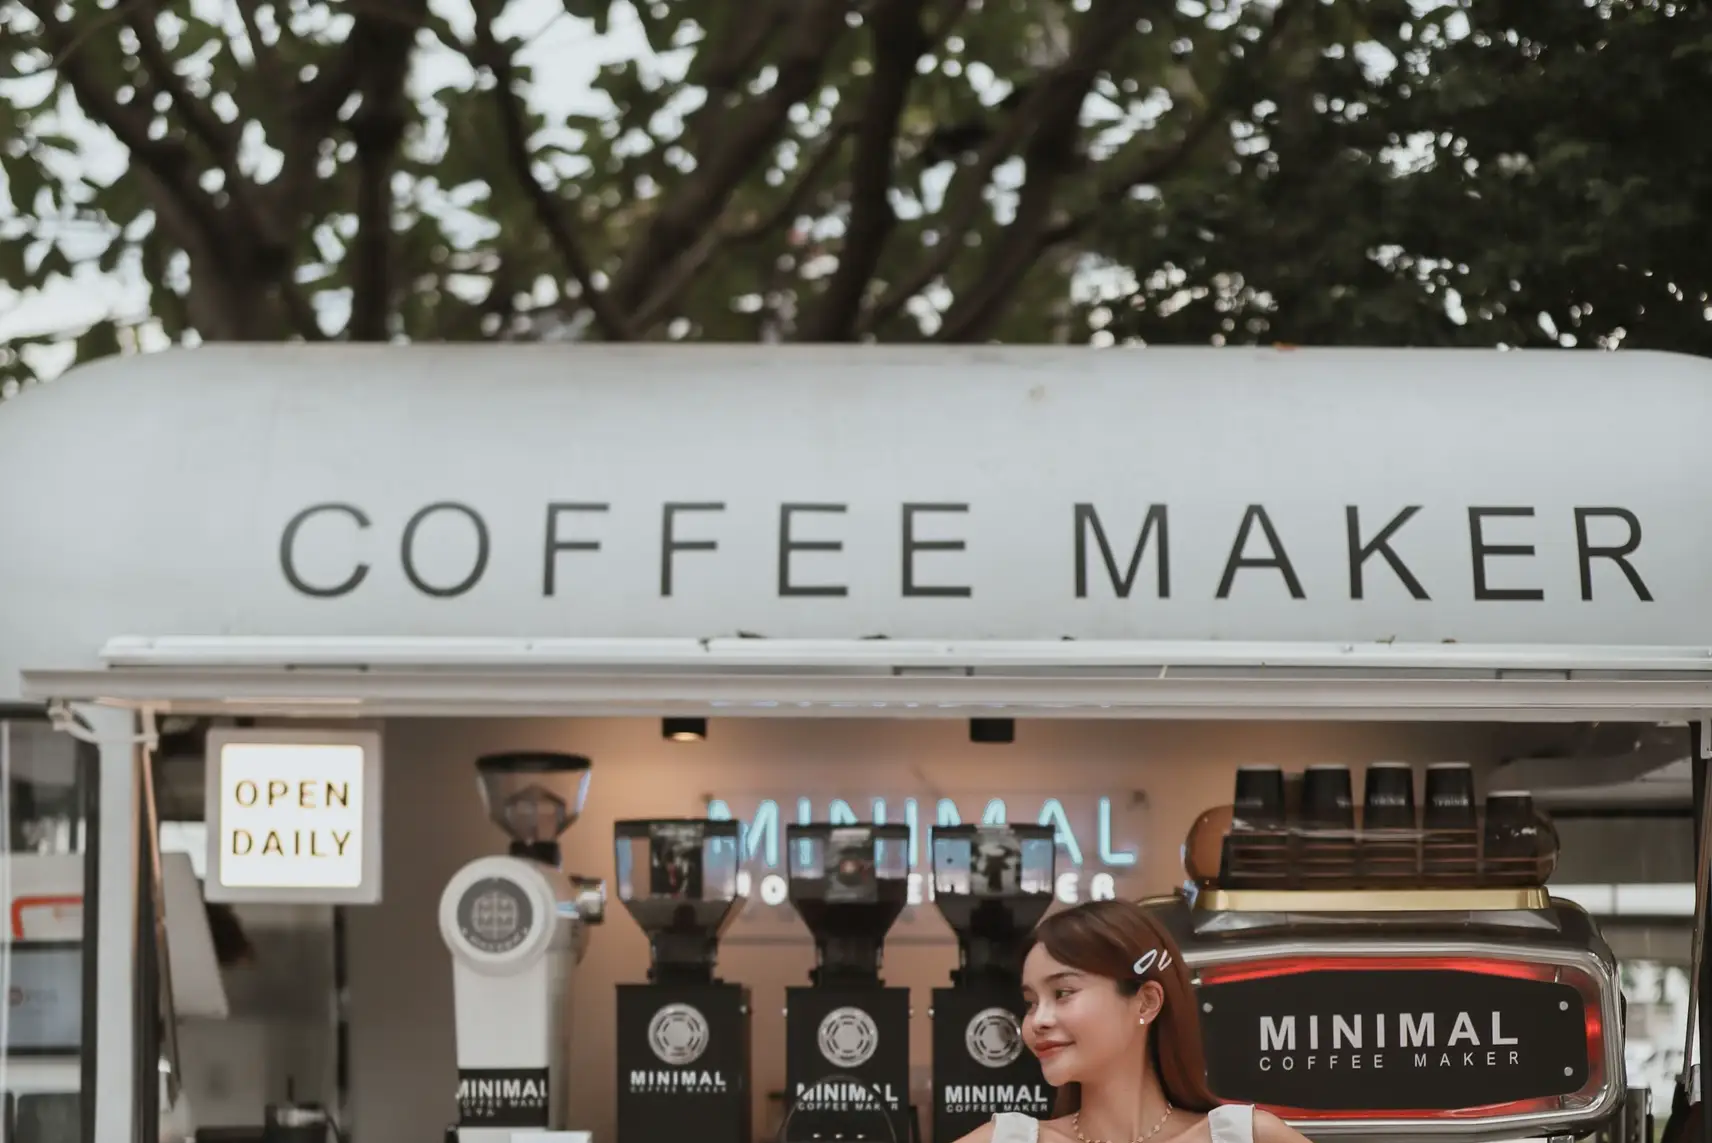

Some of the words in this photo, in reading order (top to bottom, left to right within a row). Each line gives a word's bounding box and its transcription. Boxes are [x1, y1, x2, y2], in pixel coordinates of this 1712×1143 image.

[279, 501, 972, 599] COFFEE
[1073, 503, 1655, 602] MAKER
[235, 780, 348, 808] OPEN
[232, 829, 351, 857] DAILY
[1259, 1011, 1519, 1051] MINIMAL
[1259, 1054, 1384, 1071] COFFEE
[1414, 1051, 1519, 1068] MAKER
[630, 1071, 727, 1086] MINIMAL
[944, 1085, 1048, 1103] MINIMAL
[855, 1102, 899, 1111] MAKR
[945, 1103, 997, 1113] COFFEE
[1003, 1102, 1048, 1112] MAKER
